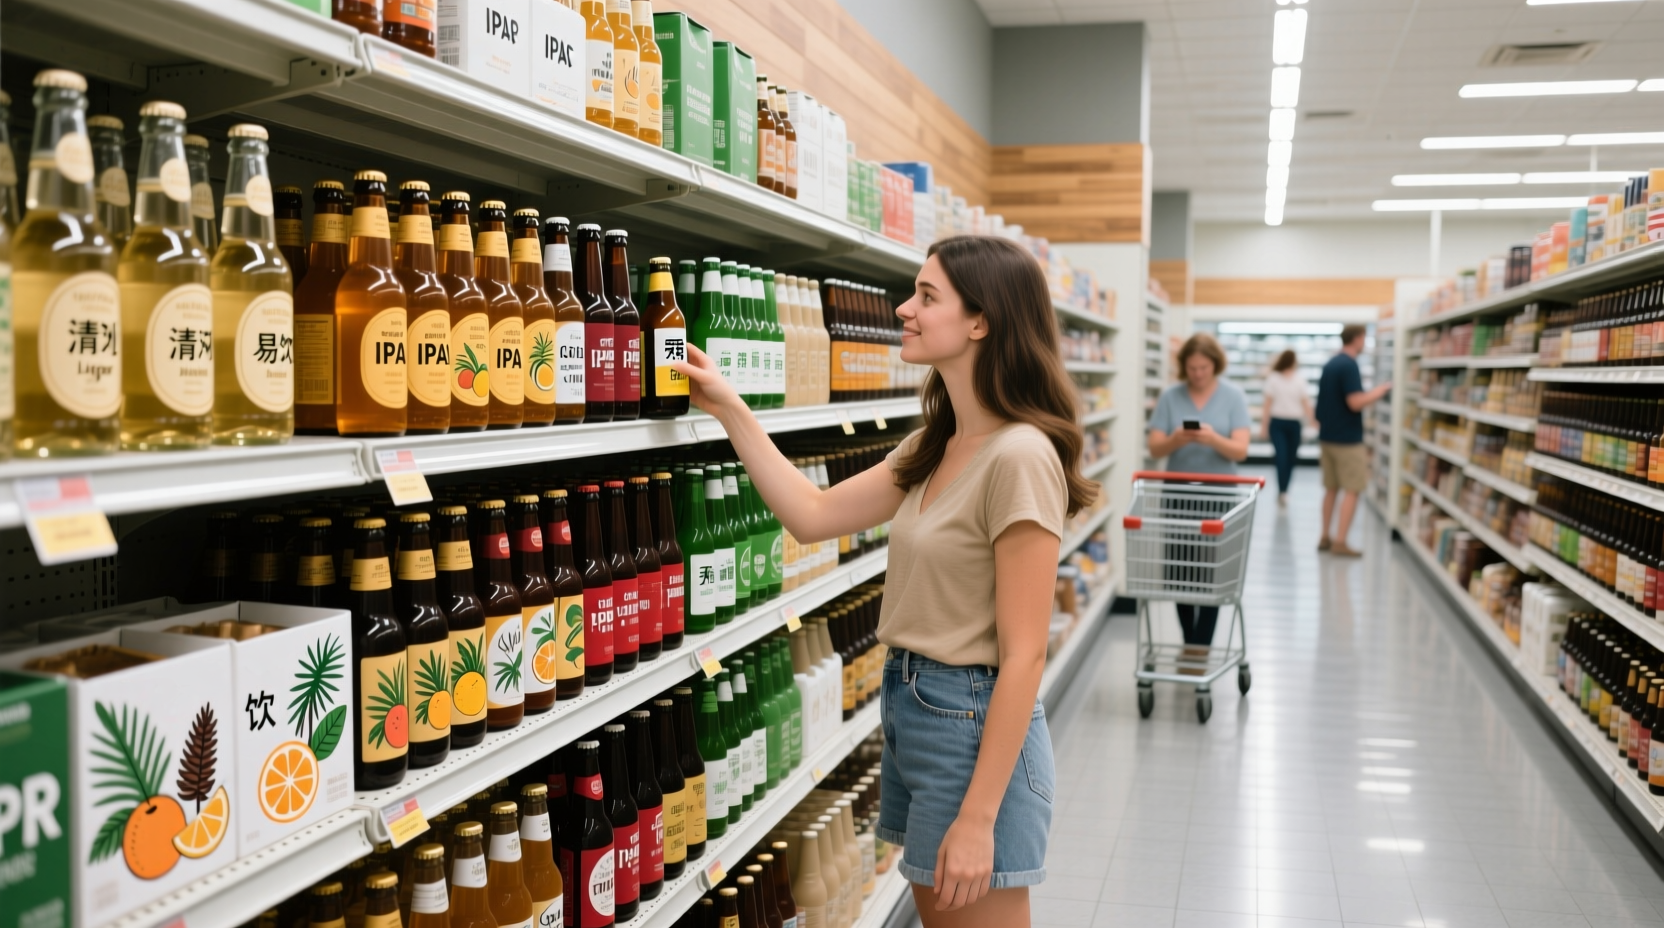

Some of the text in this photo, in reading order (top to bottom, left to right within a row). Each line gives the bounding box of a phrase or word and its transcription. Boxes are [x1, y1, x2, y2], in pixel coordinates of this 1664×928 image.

[375, 341, 406, 365] IPA
[496, 347, 522, 369] IPA
[245, 690, 276, 731] 饮
